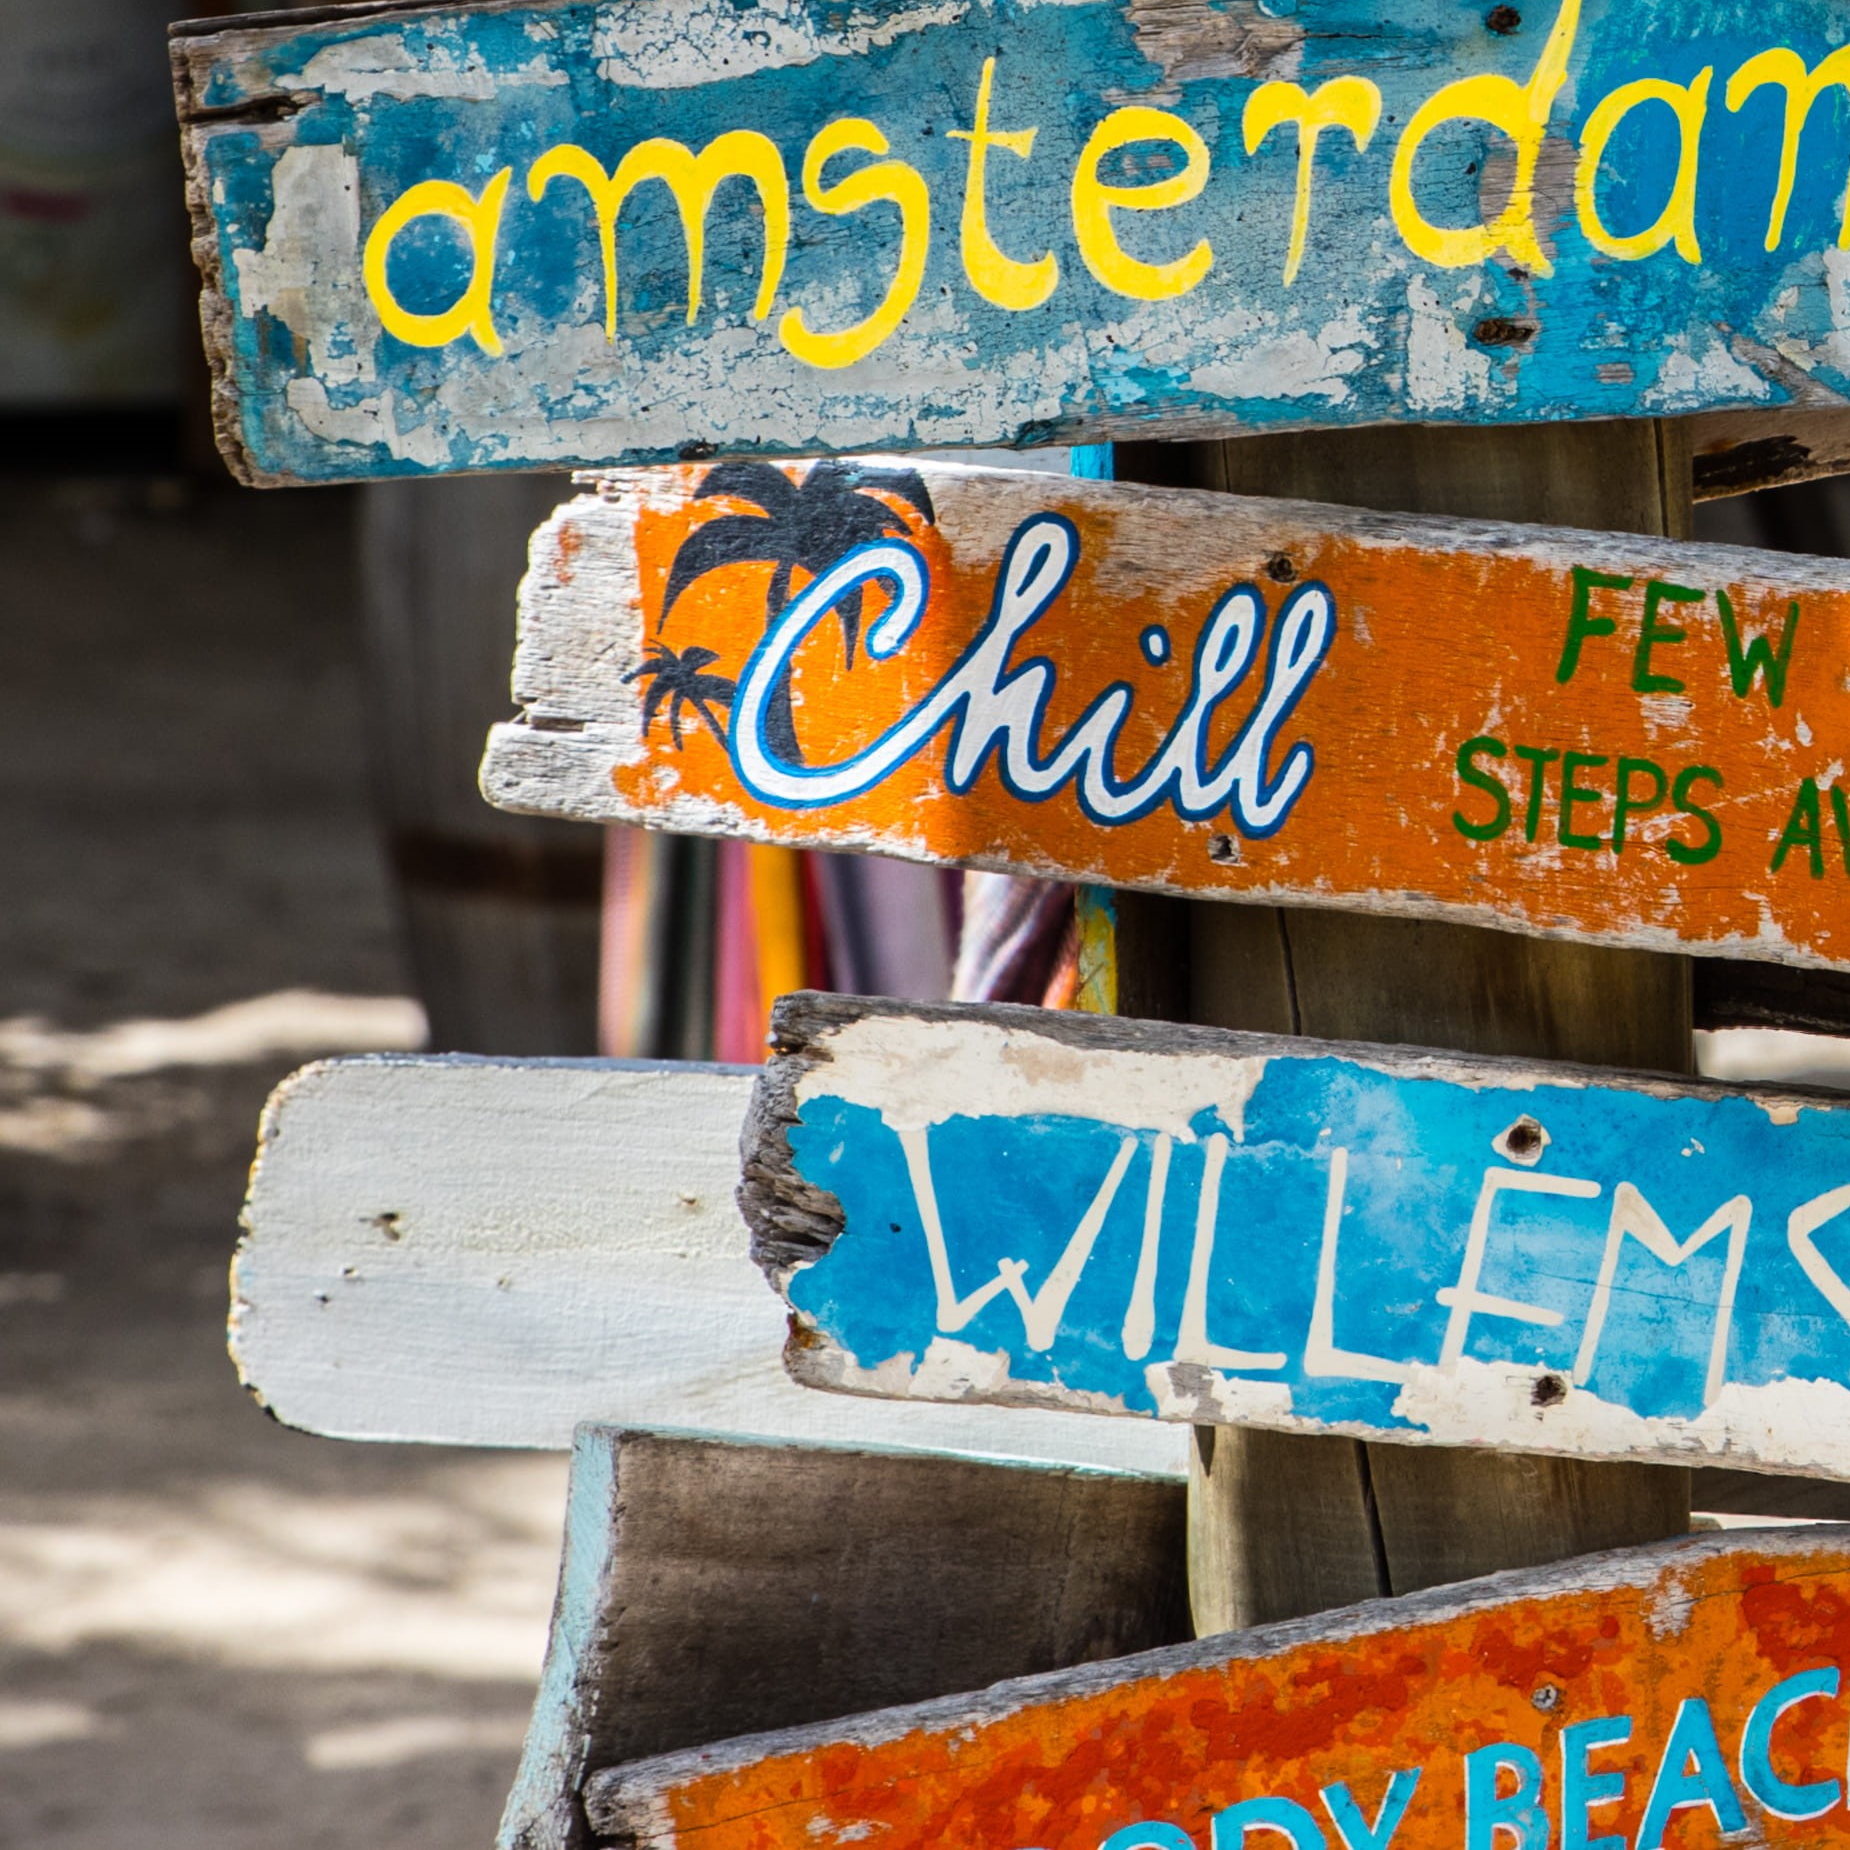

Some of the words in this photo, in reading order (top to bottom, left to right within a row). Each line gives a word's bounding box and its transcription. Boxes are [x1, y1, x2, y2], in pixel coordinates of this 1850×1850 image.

[728, 512, 1336, 839] Chill
[1555, 565, 1799, 708] FEW
[1452, 736, 1724, 865] STEPS
